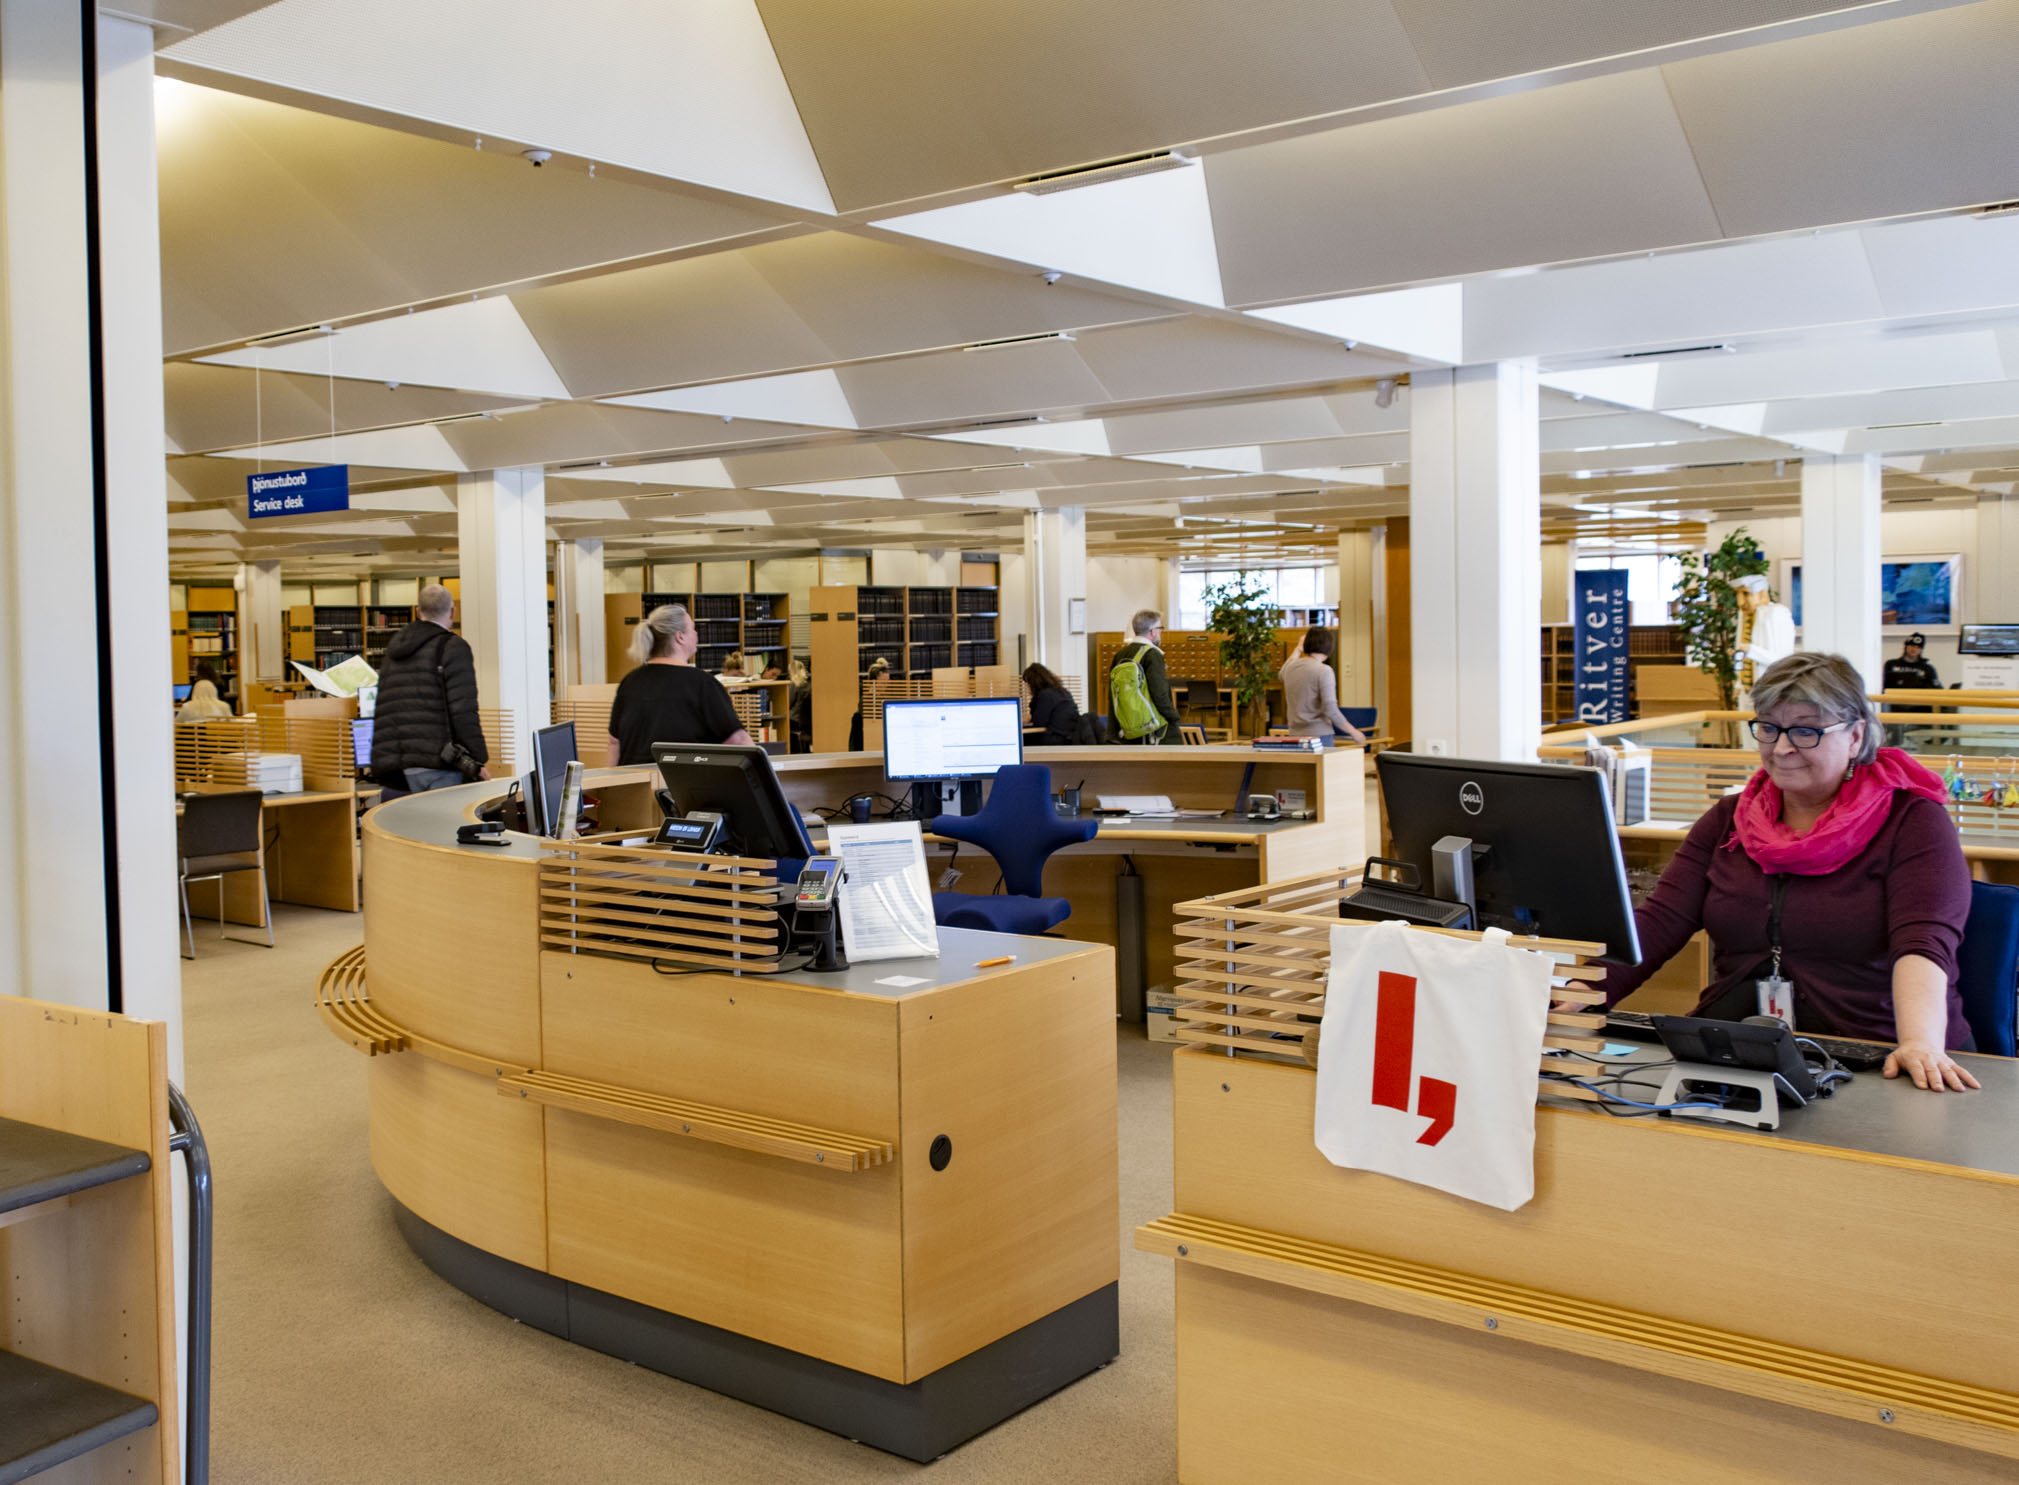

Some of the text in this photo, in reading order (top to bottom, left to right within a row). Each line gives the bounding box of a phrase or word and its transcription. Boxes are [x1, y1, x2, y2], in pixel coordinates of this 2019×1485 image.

[253, 494, 304, 512] Service desk
[1579, 589, 1608, 723] Ritver
[1610, 588, 1627, 723] Writing Centre
[1463, 793, 1481, 803] DELL
